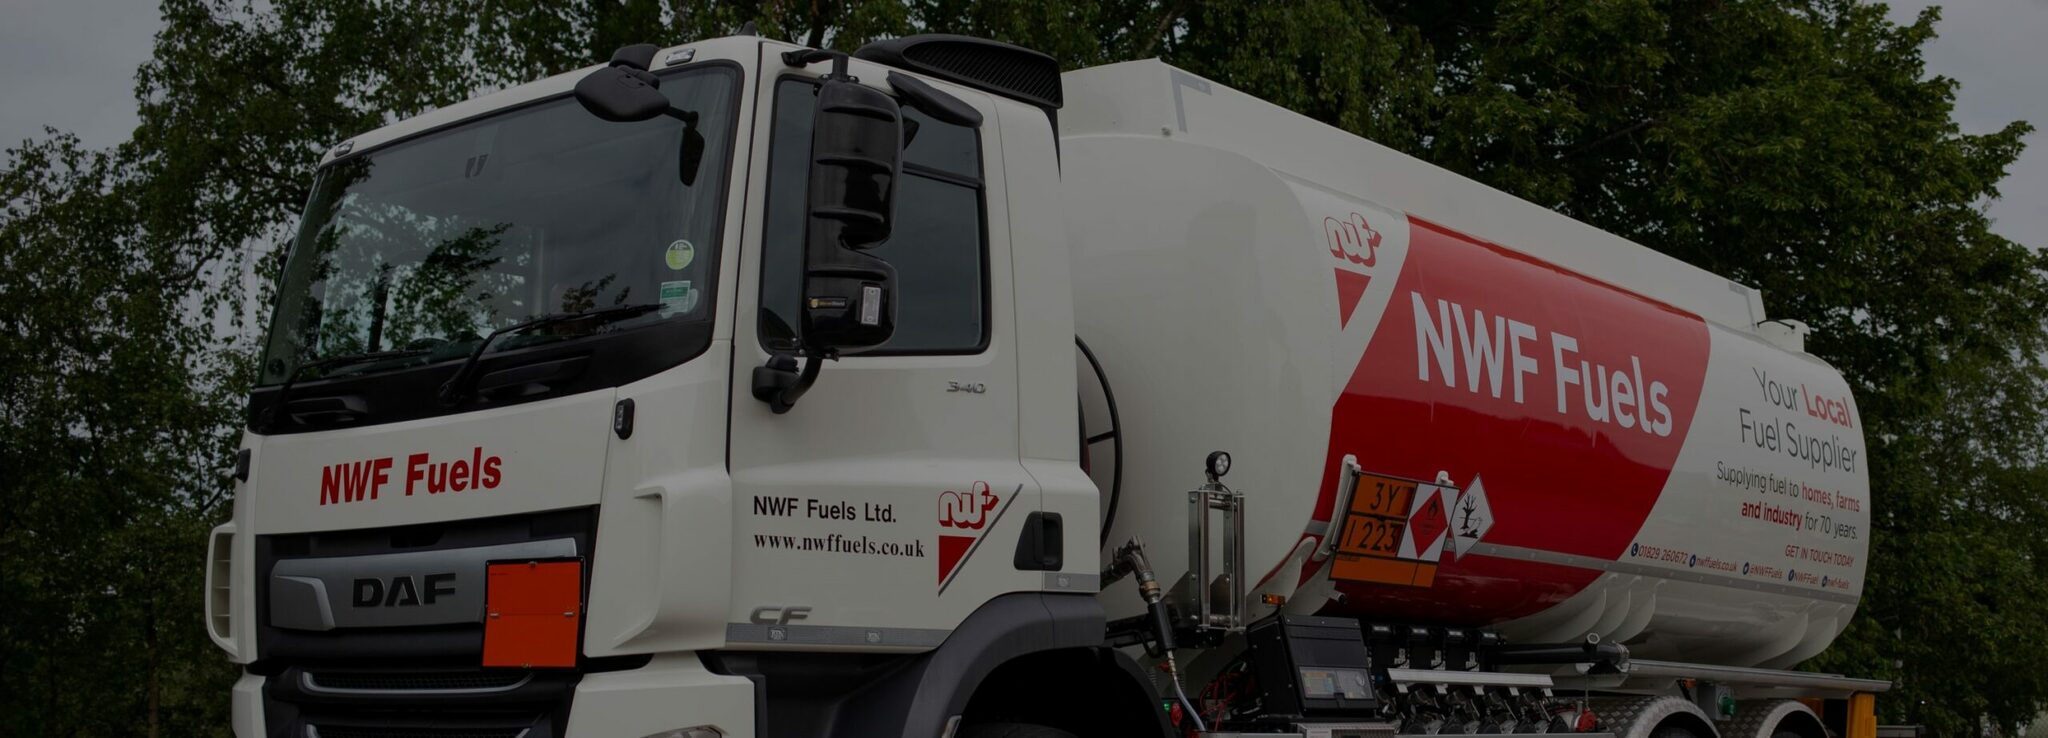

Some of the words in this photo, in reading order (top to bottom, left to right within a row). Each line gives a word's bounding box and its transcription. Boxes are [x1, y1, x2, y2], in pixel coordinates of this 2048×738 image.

[1411, 290, 1538, 404] NWF
[1551, 330, 1673, 438] Fuels
[946, 381, 986, 394] 340
[1752, 366, 1798, 411] Your
[1801, 383, 1853, 429] Local
[1739, 407, 1781, 452] Fuel
[1785, 421, 1857, 474] Supplier
[320, 457, 393, 506] NWF
[405, 446, 502, 496] Fuels
[1717, 460, 1767, 494] Supplying
[1768, 472, 1787, 494] fuel
[1789, 480, 1799, 498] to
[1801, 482, 1834, 510] homes,
[1836, 490, 1860, 513] farms
[753, 496, 799, 517] NWF
[807, 498, 857, 521] Fuels
[864, 502, 897, 523] Ltd.
[1370, 482, 1401, 512] 3Y
[1741, 501, 1761, 520] and
[1763, 502, 1803, 532] industry
[1804, 514, 1818, 530] for
[1819, 515, 1832, 534] 70
[1833, 521, 1858, 541] years.
[754, 533, 924, 558] www.nwffuels.co.uk
[1638, 545, 1660, 560] 01829
[1662, 550, 1688, 564] 260672
[1785, 544, 1800, 558] GET
[1800, 547, 1808, 560] IN
[1809, 549, 1832, 564] TOUCH
[1833, 553, 1854, 568] TODAY
[352, 572, 456, 608] DAF
[750, 606, 813, 625] CF
